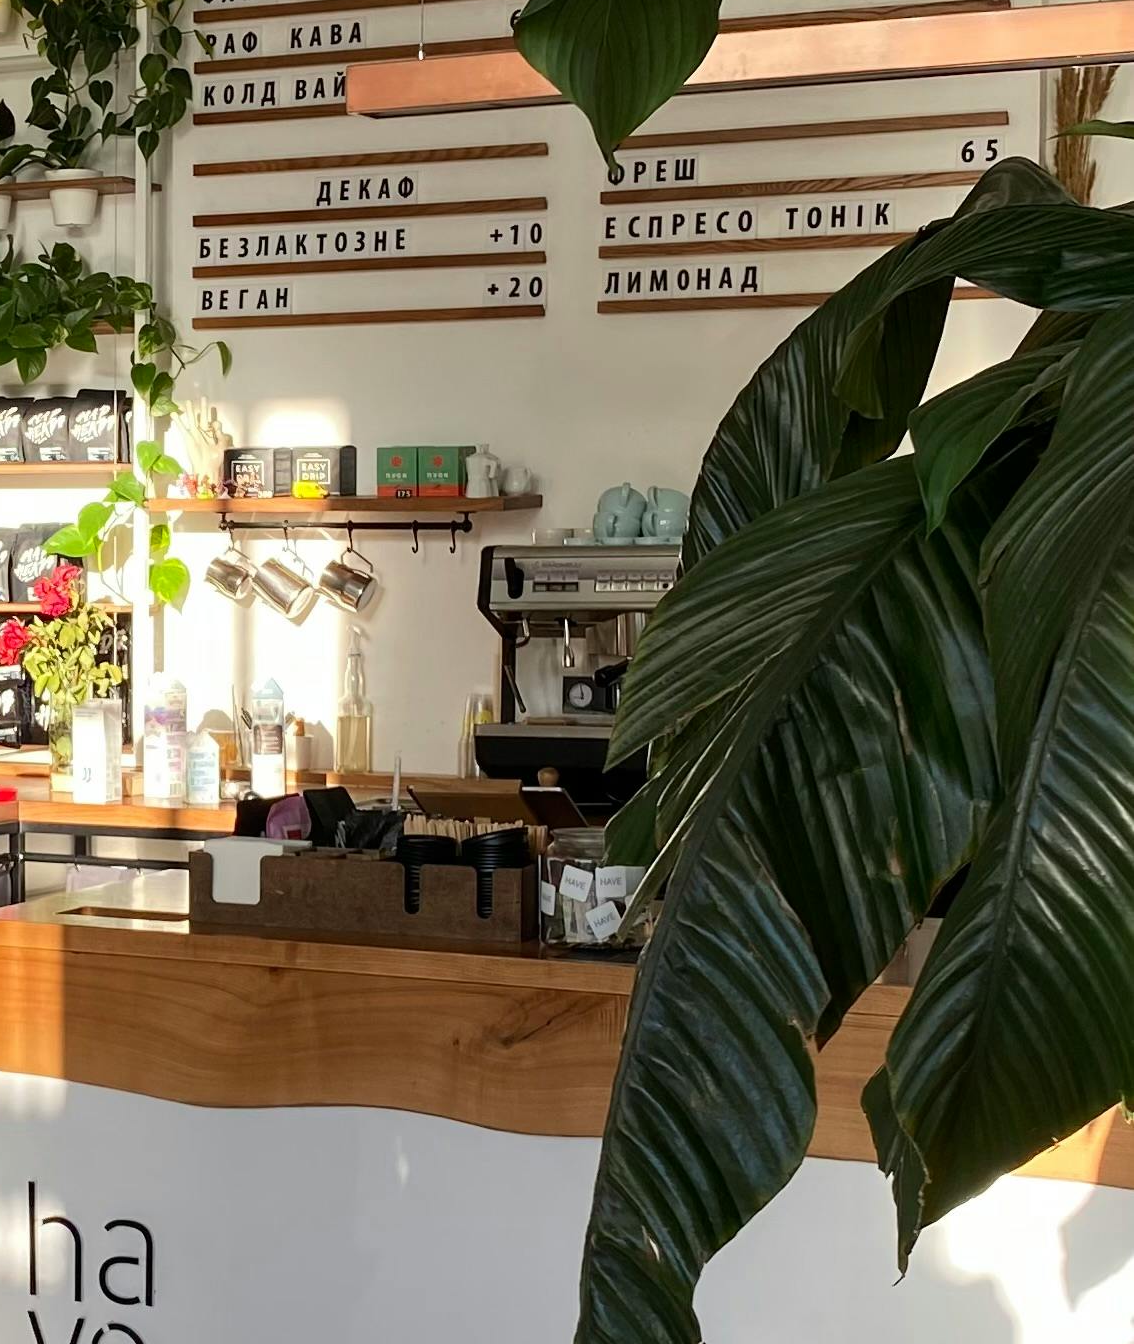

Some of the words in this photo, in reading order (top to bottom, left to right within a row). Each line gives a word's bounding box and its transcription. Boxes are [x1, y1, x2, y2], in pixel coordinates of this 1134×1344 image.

[205, 31, 258, 55] РАФ
[290, 22, 362, 49] КАВА
[203, 81, 276, 107] КОЛД
[295, 71, 346, 101] ВАЙ
[607, 158, 696, 186] ФРЕШ
[961, 139, 998, 163] 65
[316, 176, 414, 207] ДЕКАФ
[605, 210, 753, 239] ЕСПРЕСО
[785, 202, 890, 230] ТОНІК
[199, 227, 407, 260] БЕЗЛАКТОЗНЕ
[489, 222, 543, 245] +10
[201, 287, 288, 311] ВЕГАН
[487, 276, 543, 298] +20
[604, 265, 758, 295] ЛИМОНАД
[235, 464, 261, 473] EASY
[301, 463, 327, 472] EASY
[301, 472, 326, 481] DRIP
[566, 875, 586, 889] HAVE
[599, 877, 623, 886] HAVE
[593, 912, 617, 928] HAVE
[28, 1181, 156, 1307] ha
